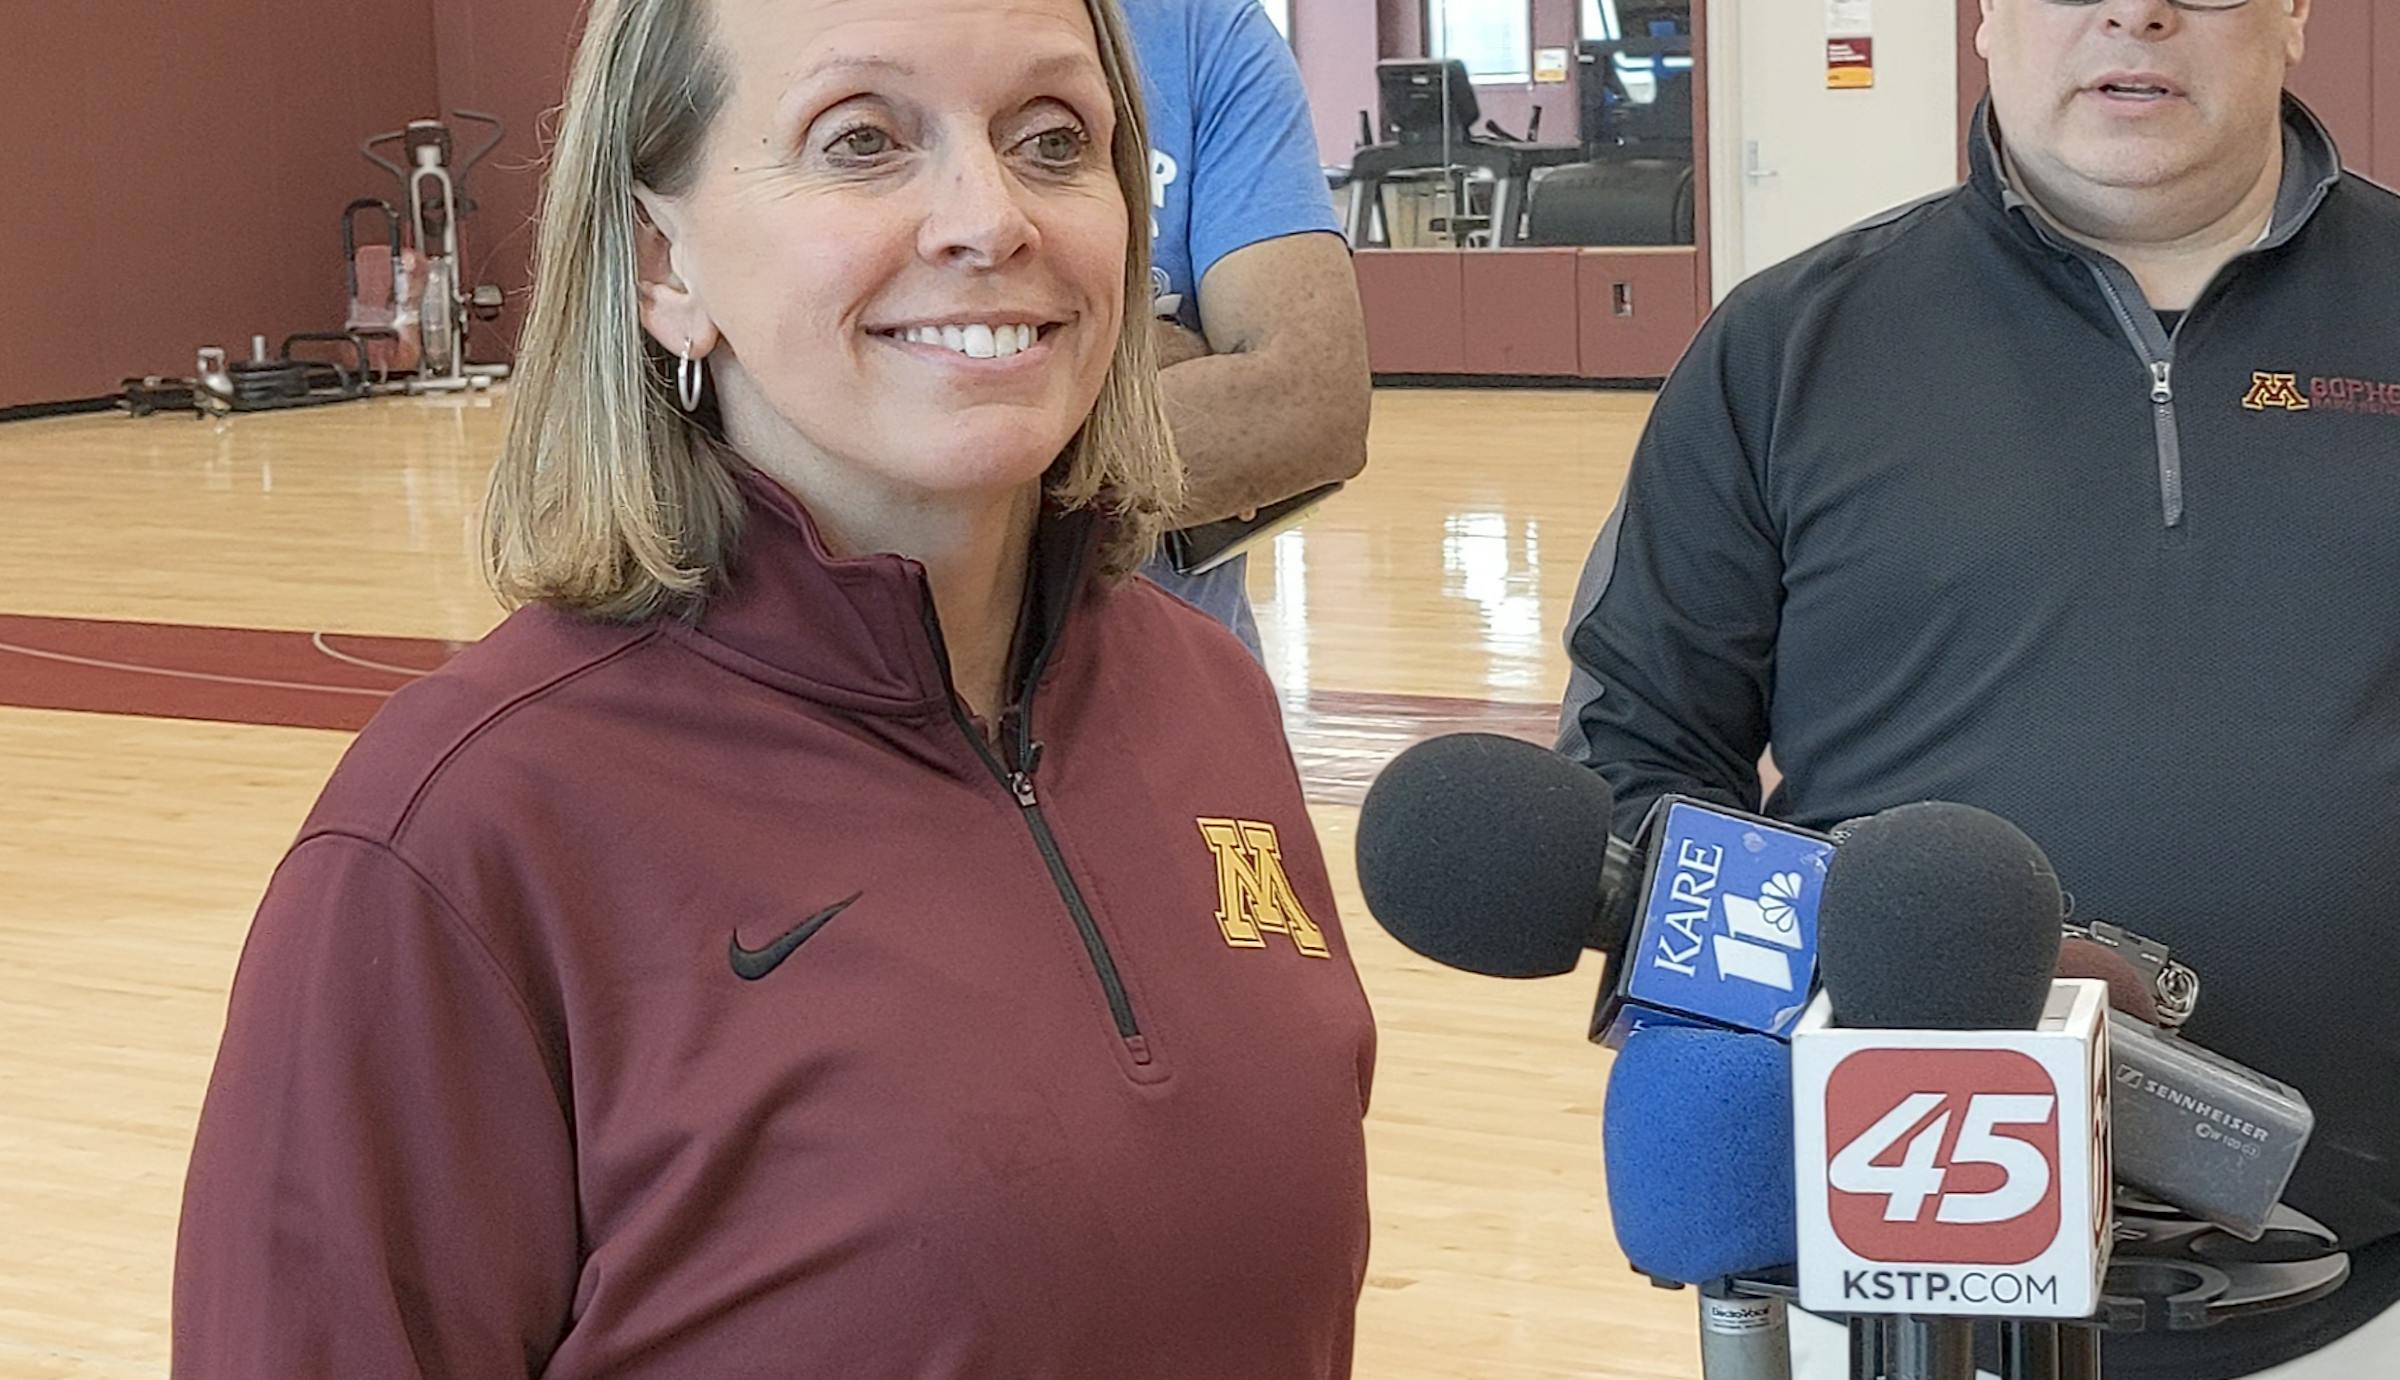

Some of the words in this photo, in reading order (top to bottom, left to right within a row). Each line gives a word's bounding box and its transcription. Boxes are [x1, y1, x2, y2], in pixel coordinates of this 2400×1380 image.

[2241, 371, 2310, 411] M
[1196, 816, 1331, 958] M
[1653, 838, 1724, 978] KARE
[1712, 892, 1804, 993] 11
[1828, 1092, 2055, 1224] 45
[2144, 1079, 2269, 1143] SENNHEISER
[1843, 1269, 2057, 1305] KSTP.COM
